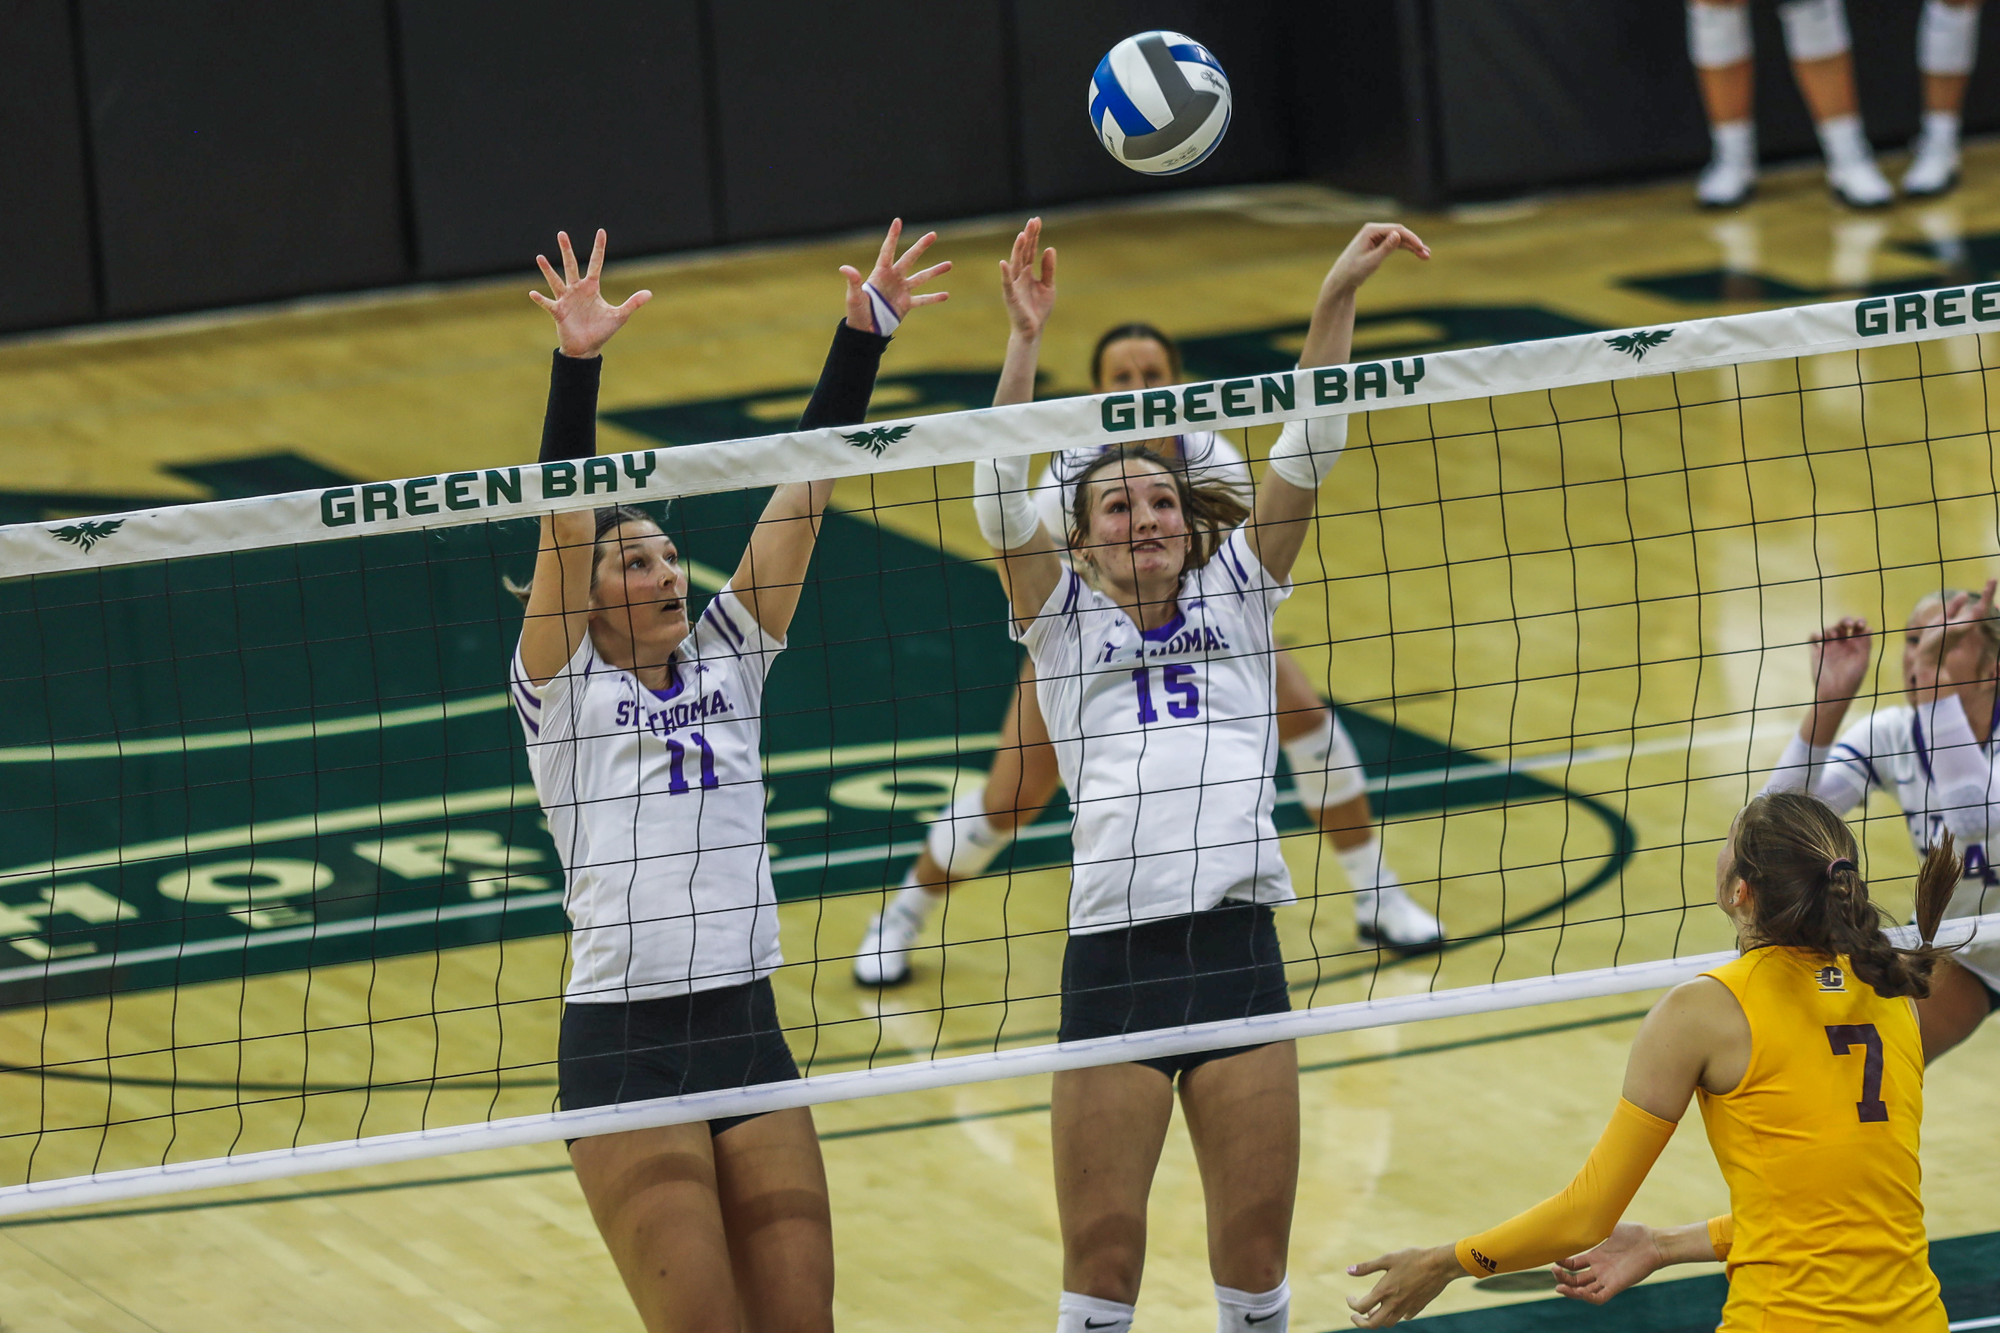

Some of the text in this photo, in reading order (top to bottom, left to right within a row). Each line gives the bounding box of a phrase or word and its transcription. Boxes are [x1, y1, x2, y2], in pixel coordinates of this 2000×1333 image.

[1855, 284, 2000, 337] GREE
[1101, 357, 1425, 433] GREEN BAY
[321, 451, 656, 528] GREEN BAY
[1132, 665, 1200, 725] 15
[666, 732, 719, 796] 11
[1824, 1023, 1889, 1123] 7
